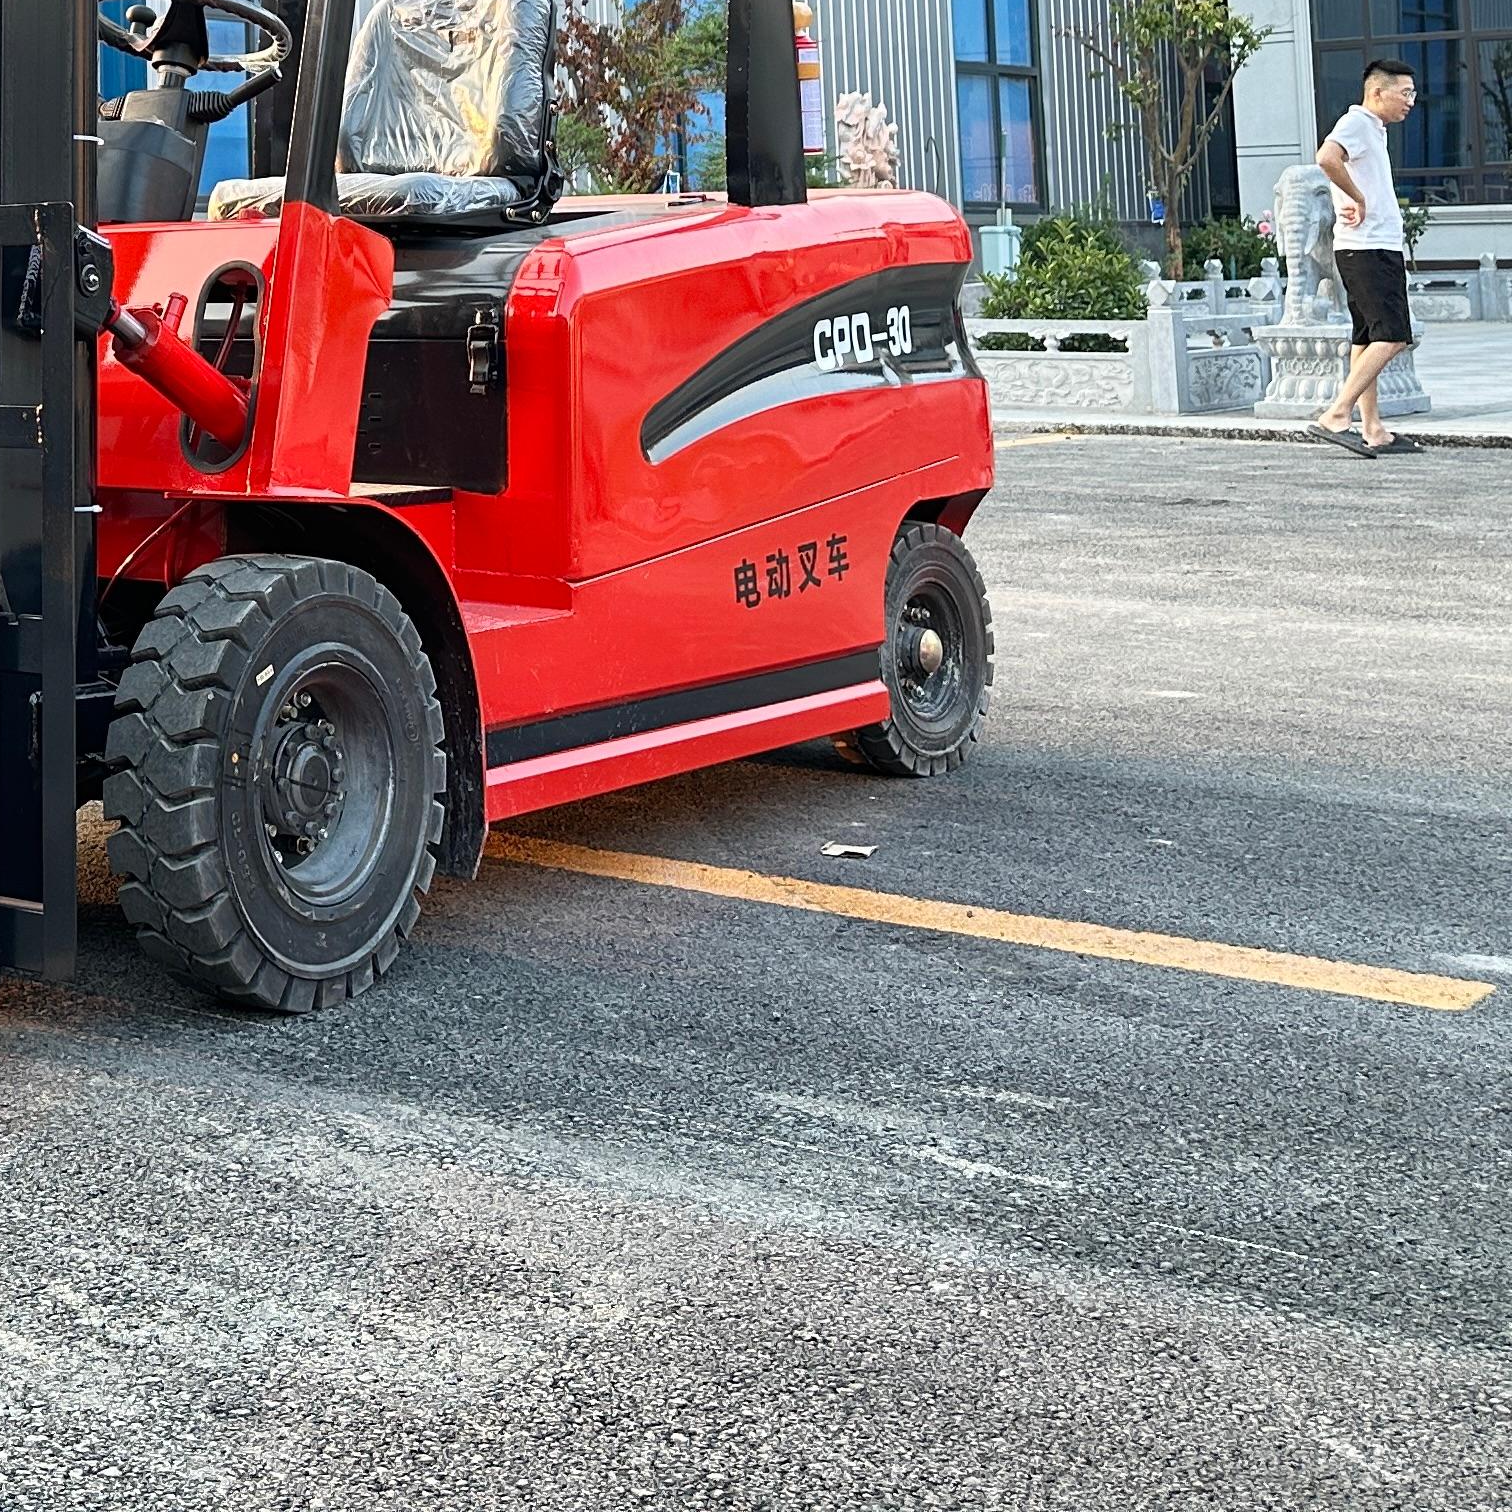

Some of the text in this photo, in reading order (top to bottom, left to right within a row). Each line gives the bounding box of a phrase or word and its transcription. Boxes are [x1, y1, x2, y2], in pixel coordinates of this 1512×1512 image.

[813, 305, 913, 371] CPD-30
[734, 533, 850, 609] 电动叉车
